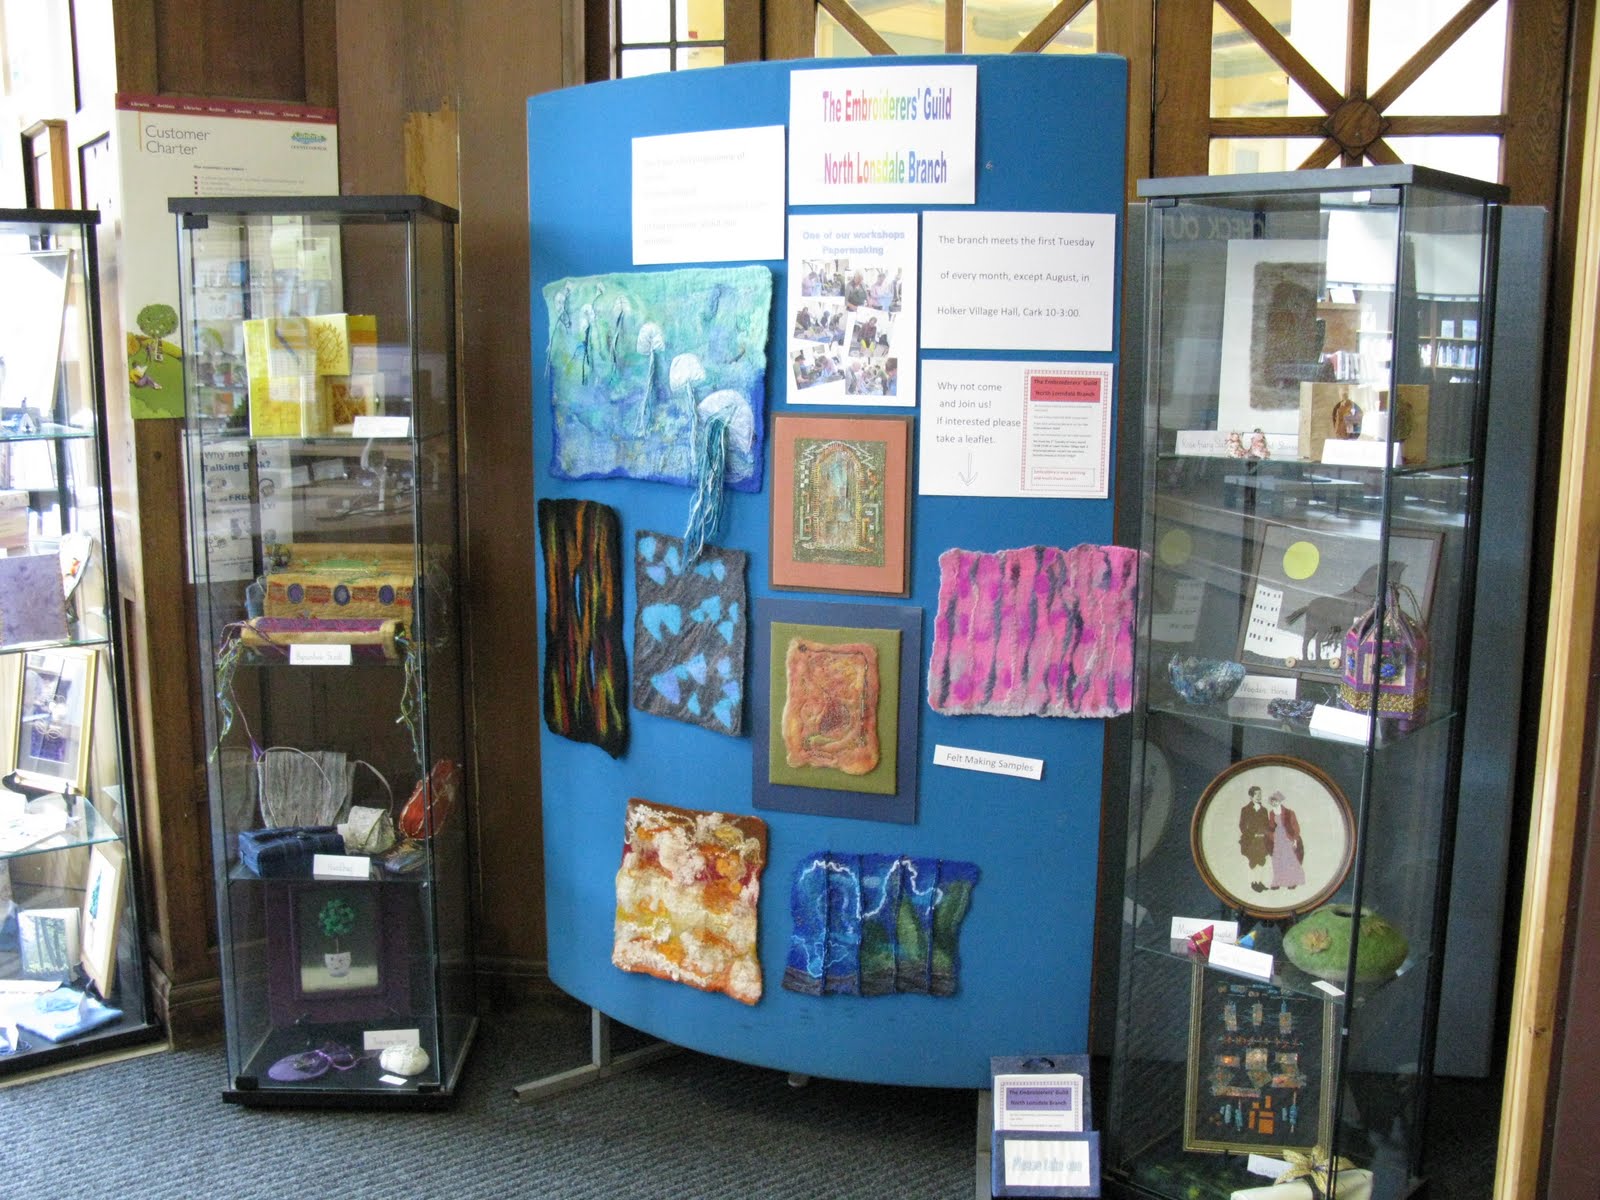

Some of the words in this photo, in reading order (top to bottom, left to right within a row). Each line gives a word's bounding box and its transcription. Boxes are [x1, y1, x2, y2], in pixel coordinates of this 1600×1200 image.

[822, 90, 842, 122] The
[845, 88, 920, 122] Embroiderers'
[923, 87, 953, 121] Guild
[145, 124, 211, 141] Customer
[146, 140, 198, 155] Charter
[824, 151, 853, 184] North
[856, 151, 905, 184] Lonsdale
[908, 150, 947, 184] Branch
[802, 231, 821, 240] One
[823, 231, 833, 240] of
[835, 231, 851, 240] our
[853, 230, 905, 241] workshops
[939, 235, 955, 245] The
[957, 235, 988, 245] branch
[990, 237, 1019, 246] meets
[1021, 235, 1036, 245] the
[1038, 236, 1056, 246] first
[1058, 237, 1096, 248] Tuesday
[822, 245, 884, 256] Papermaking
[940, 271, 950, 280] of
[951, 272, 977, 282] every
[978, 271, 1012, 282] month,
[1013, 273, 1043, 283] except
[1045, 272, 1079, 284] August,
[1081, 273, 1090, 283] in
[937, 305, 966, 316] Holker
[968, 306, 998, 317] Village
[1000, 306, 1021, 318] Hall,
[1023, 307, 1043, 317] Cark
[937, 381, 958, 392] Why
[960, 382, 975, 391] not
[977, 383, 1003, 392] come
[939, 399, 956, 408] and
[958, 399, 976, 408] Join
[978, 400, 992, 409] us!
[944, 417, 991, 427] interested
[992, 418, 1022, 428] please
[936, 434, 956, 443] take
[204, 450, 226, 460] Why
[204, 463, 241, 473] Talking
[243, 460, 271, 470] Bk?
[946, 753, 963, 763] Felt
[964, 755, 997, 768] Making
[998, 760, 1034, 772] Samples
